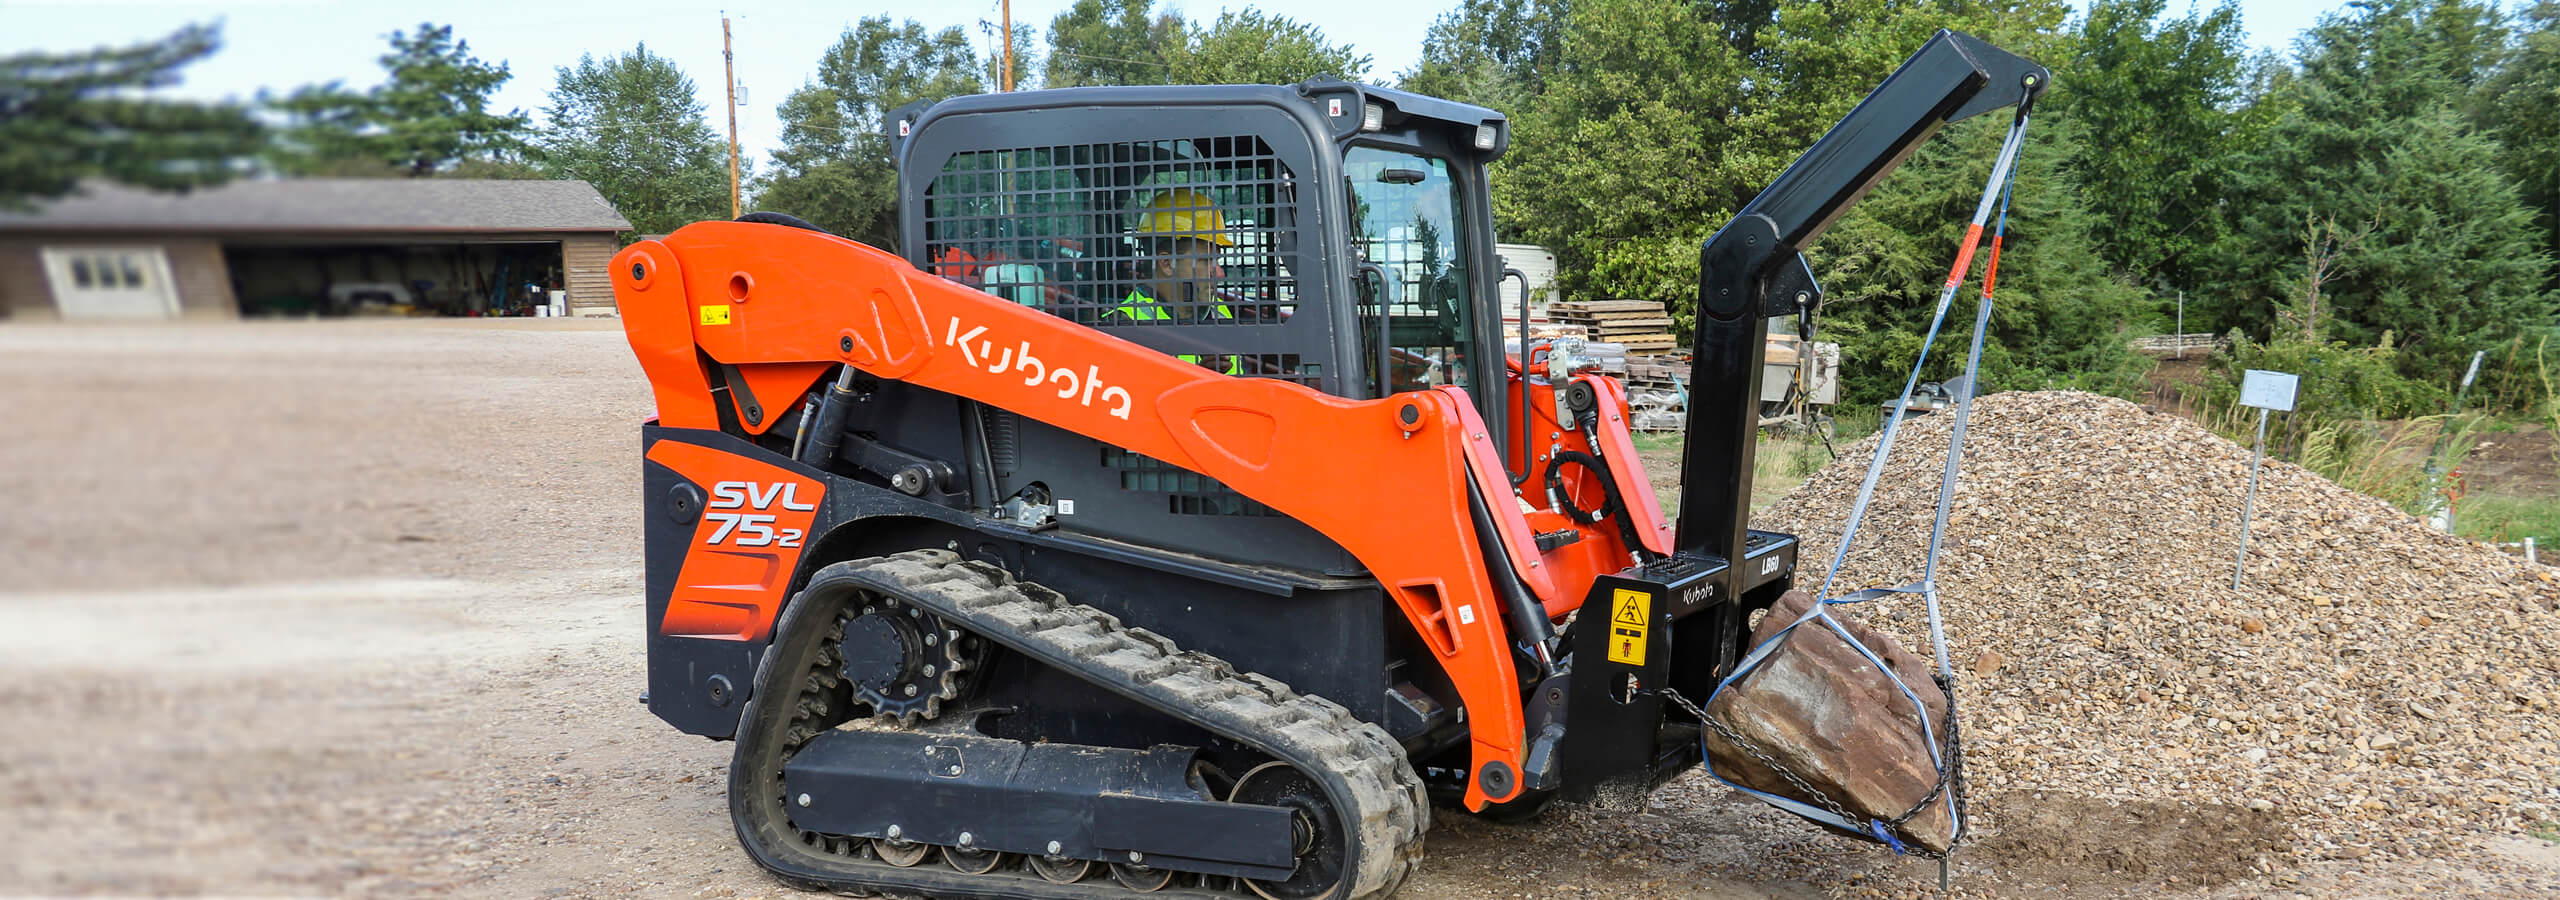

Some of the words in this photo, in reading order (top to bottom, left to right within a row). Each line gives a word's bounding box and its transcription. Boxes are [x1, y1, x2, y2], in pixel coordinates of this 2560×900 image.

[945, 316, 1132, 420] Kubota
[709, 480, 815, 511] SVL
[705, 512, 803, 548] 75-2
[1761, 554, 1780, 576] LB60
[1683, 582, 1713, 605] Kubota
